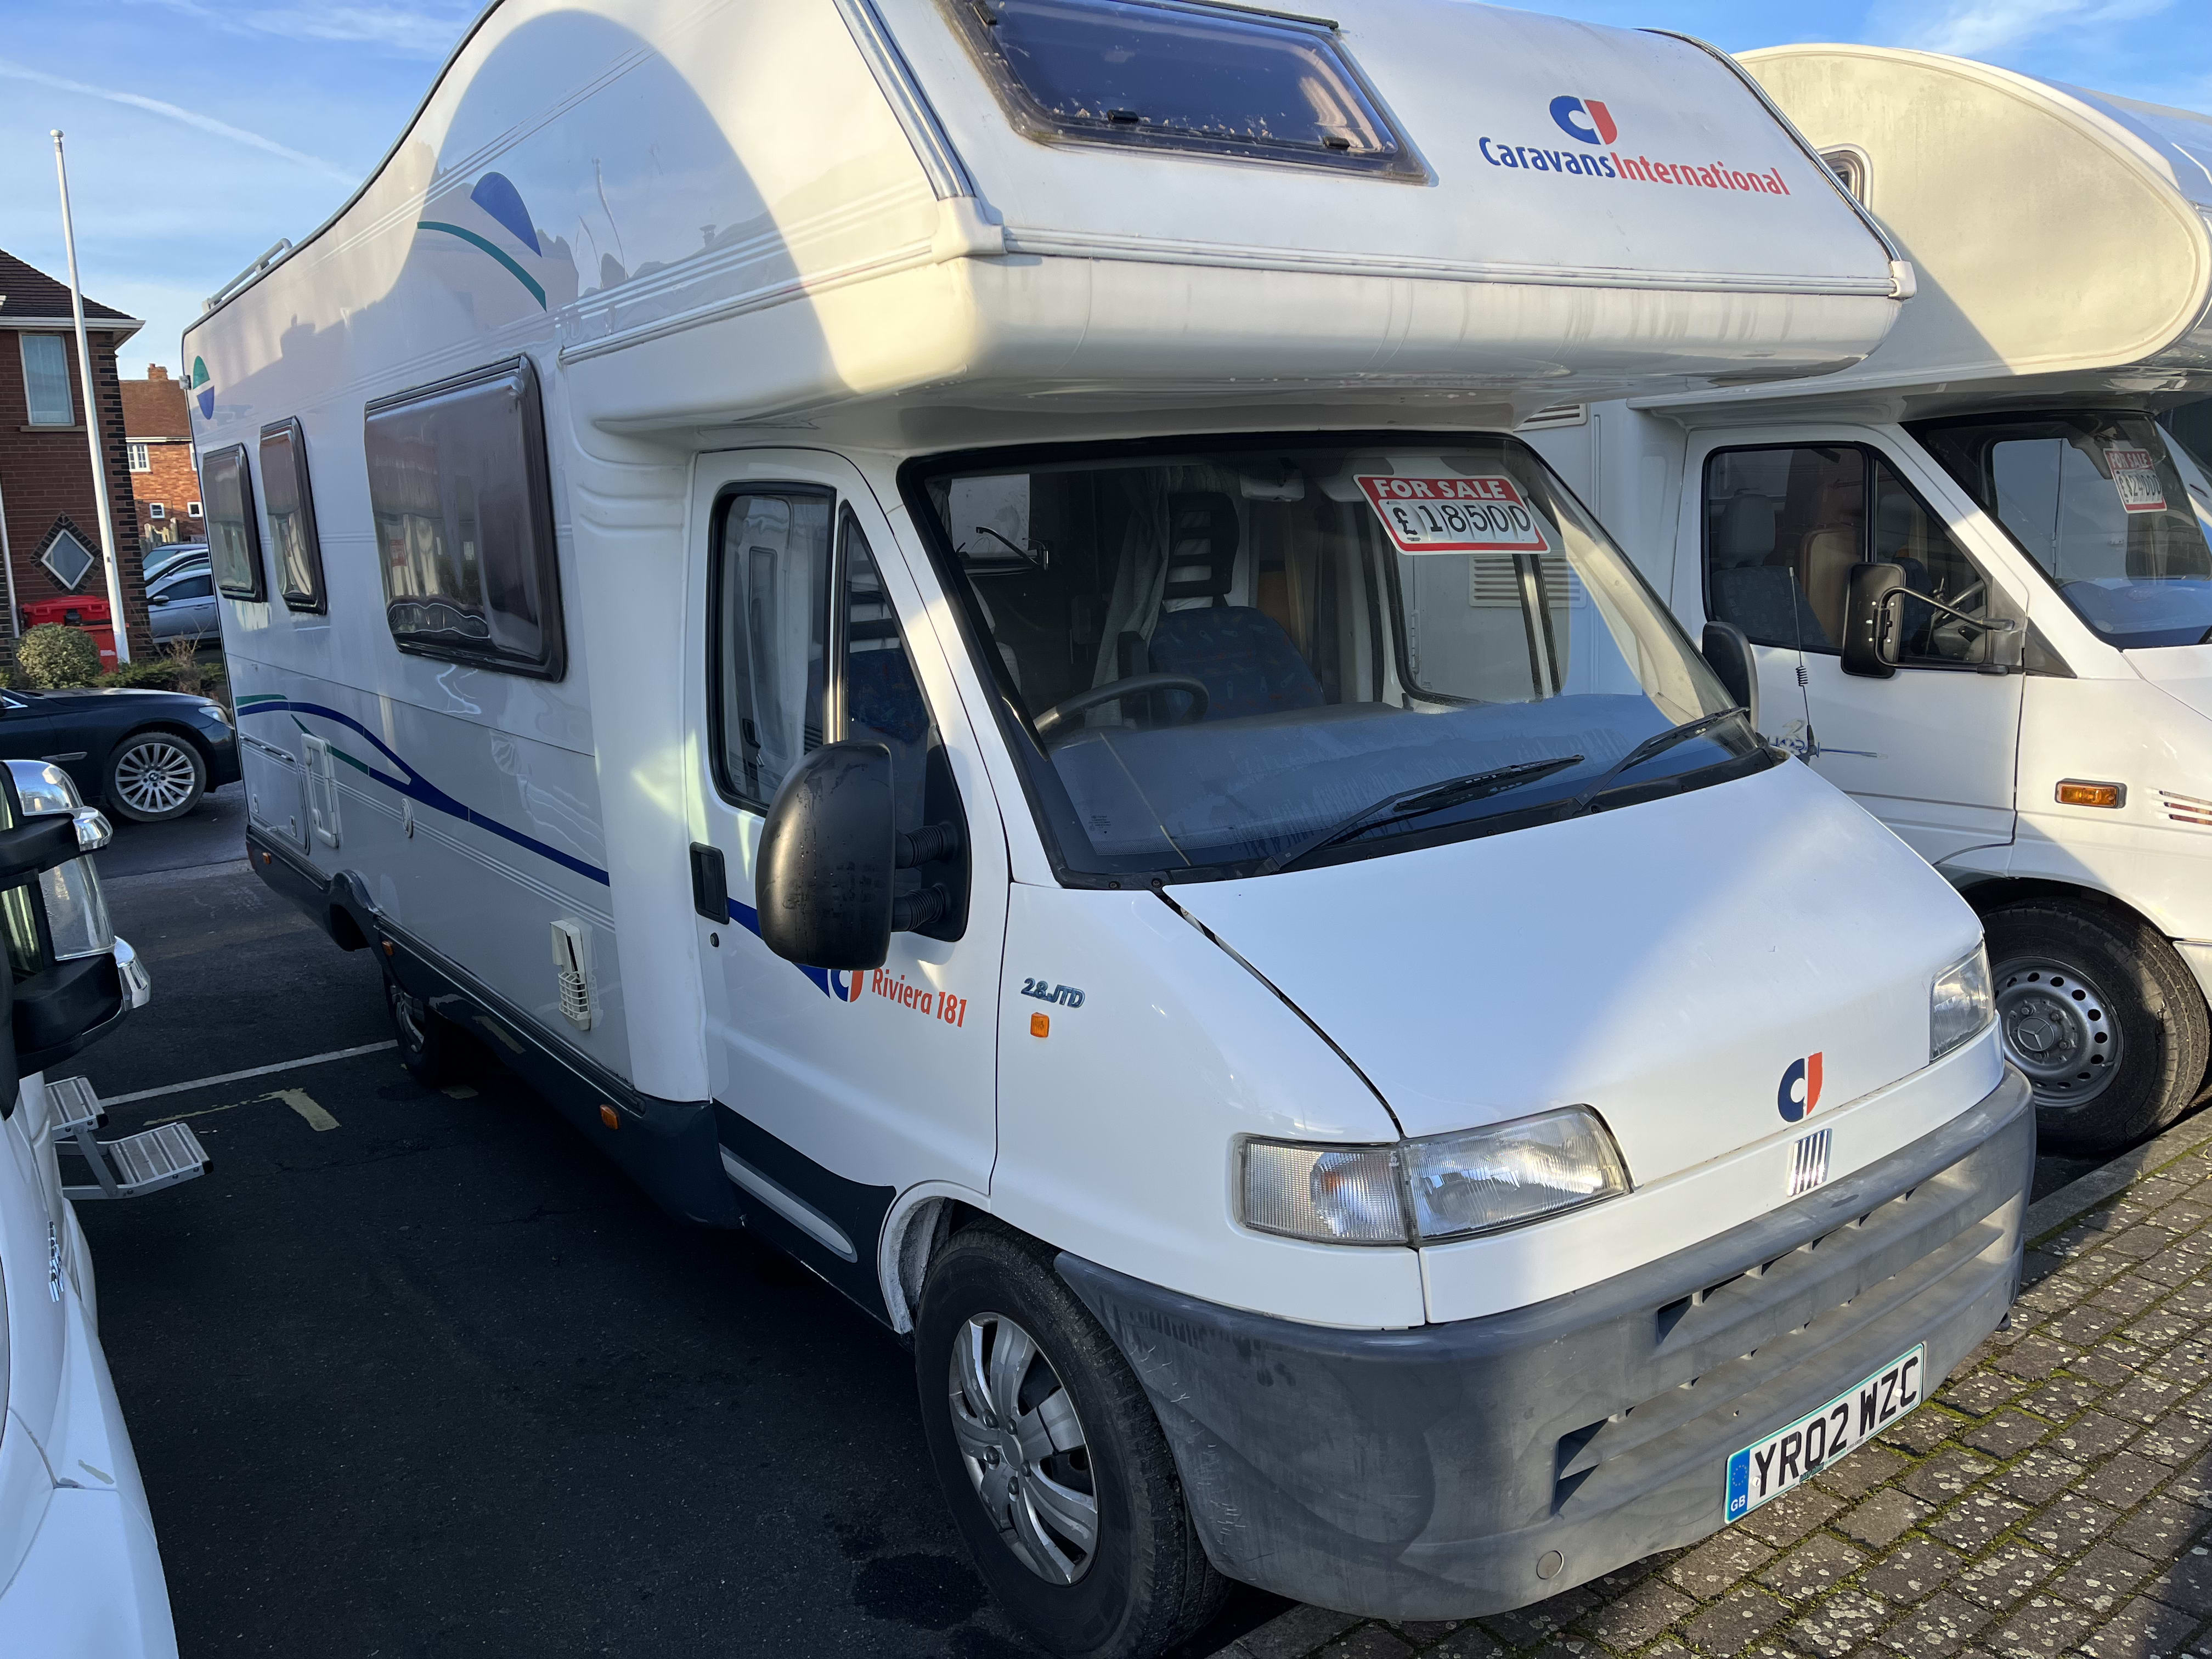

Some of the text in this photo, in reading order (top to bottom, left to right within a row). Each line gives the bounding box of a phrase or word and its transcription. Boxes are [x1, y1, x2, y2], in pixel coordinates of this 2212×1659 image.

[2109, 452, 2148, 469] FOR SALE
[1372, 479, 1506, 499] FOR SALE
[1392, 504, 1531, 535] £18500
[871, 967, 968, 1028] Riviera 181
[1755, 1356, 1918, 1498] YR02 WZC
[1730, 1494, 1746, 1512] GB
